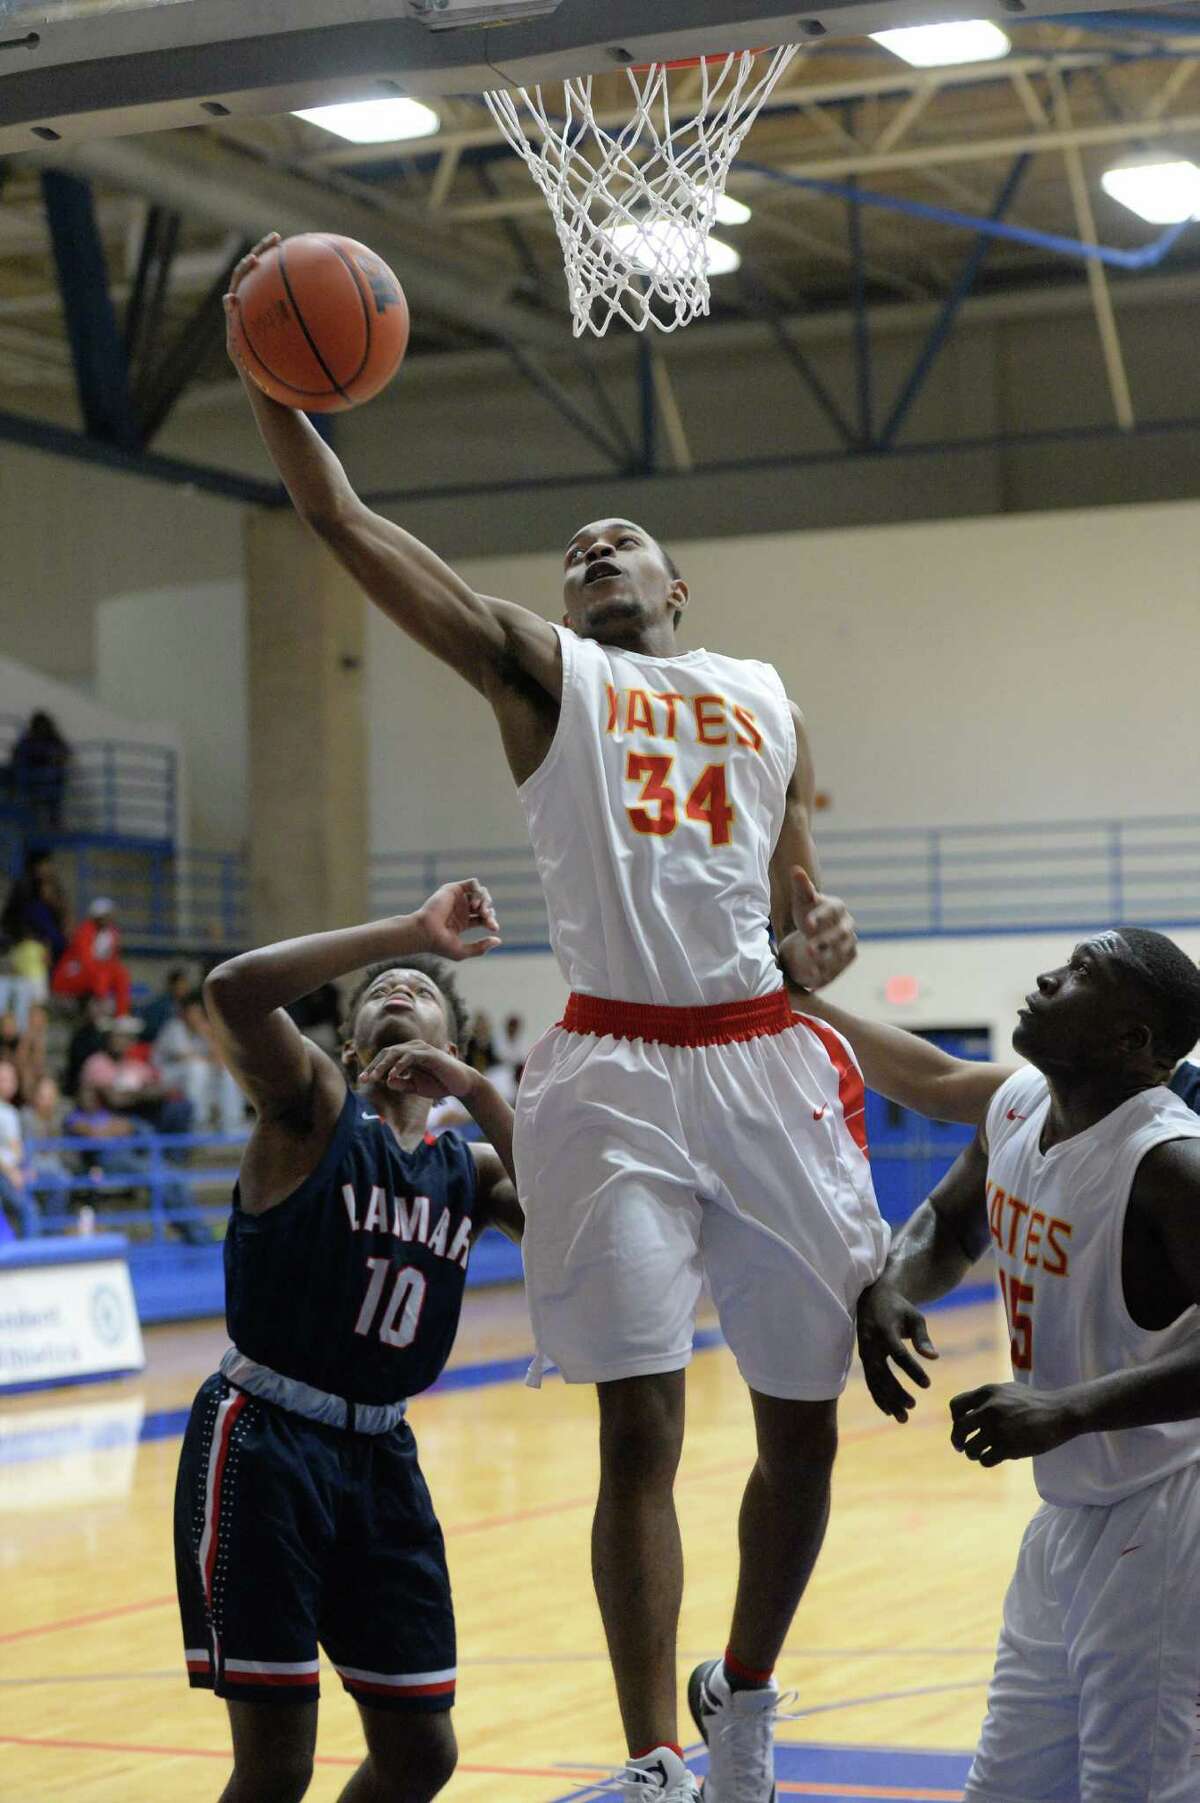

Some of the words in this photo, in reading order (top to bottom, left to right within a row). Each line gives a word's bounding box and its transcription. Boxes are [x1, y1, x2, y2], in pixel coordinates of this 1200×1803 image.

[625, 752, 736, 847] 34
[986, 1179, 1073, 1277] ATES
[354, 1257, 427, 1348] 10
